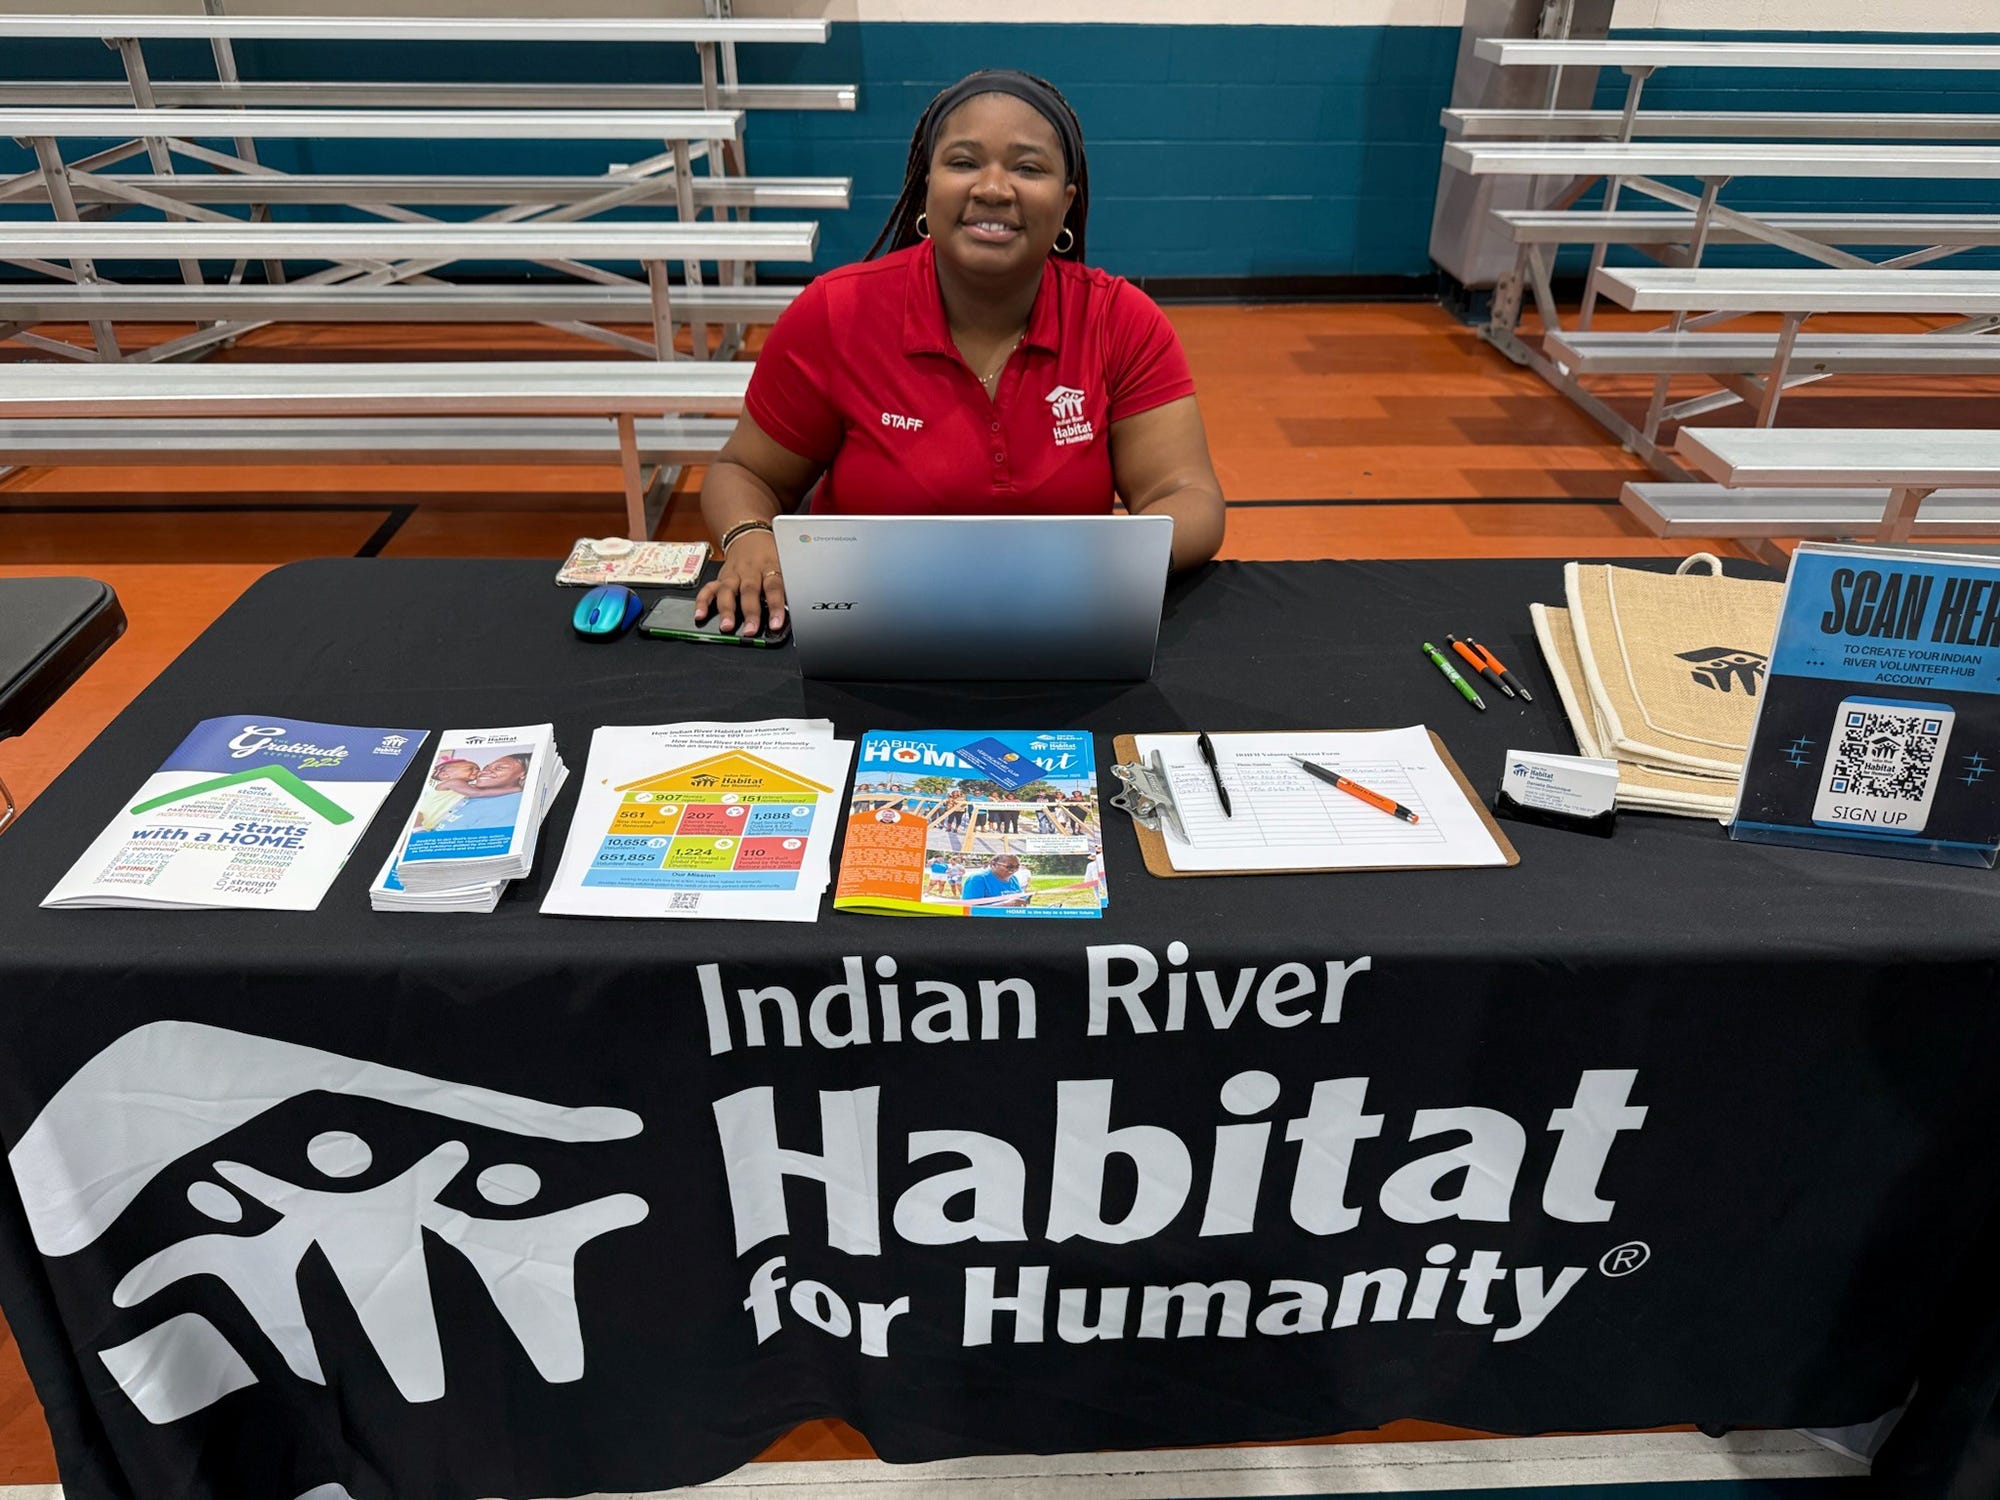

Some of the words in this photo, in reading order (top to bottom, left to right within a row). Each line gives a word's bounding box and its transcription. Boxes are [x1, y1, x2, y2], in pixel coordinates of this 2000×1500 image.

[881, 412, 924, 432] STAFF
[1053, 421, 1092, 440] Habitat
[1066, 433, 1094, 444] Humanity
[812, 602, 858, 610] acer
[1820, 568, 1934, 641] SCAN
[1843, 644, 1861, 655] TO
[1861, 645, 1908, 658] CREATE
[1908, 649, 1942, 661] YOUR
[1941, 652, 1982, 665] INDIAN
[1843, 657, 1878, 669] RIVER
[1880, 660, 1950, 675] VOLUNTEER
[1949, 665, 1975, 677] HUB
[1875, 673, 1934, 686] ACCOUNT
[228, 725, 349, 758] Gratitude
[866, 739, 938, 751] HABITAT
[1864, 762, 1896, 773] Habitat
[1530, 769, 1554, 779] Habitat
[721, 777, 763, 785] Habitat
[237, 789, 273, 797] stories
[259, 808, 299, 816] ADVOCACY
[1831, 805, 1877, 822] SIGN
[1882, 811, 1908, 825] UP
[228, 815, 271, 823] SECURITY
[231, 822, 309, 837] starts
[131, 827, 189, 841] with
[194, 833, 212, 843] a
[217, 831, 305, 850] HOME.
[231, 846, 298, 856] communities
[230, 857, 292, 868] beginnings
[226, 863, 286, 875] EDUCATIONAL
[235, 871, 283, 880] SUCCESS
[224, 885, 274, 895] FAMILY
[230, 880, 277, 888] strength
[696, 953, 1036, 1055] Indian
[1086, 940, 1372, 1038] River
[713, 1068, 1650, 1258] Habitat
[743, 1255, 909, 1358] for
[963, 1242, 1588, 1346] Humanity
